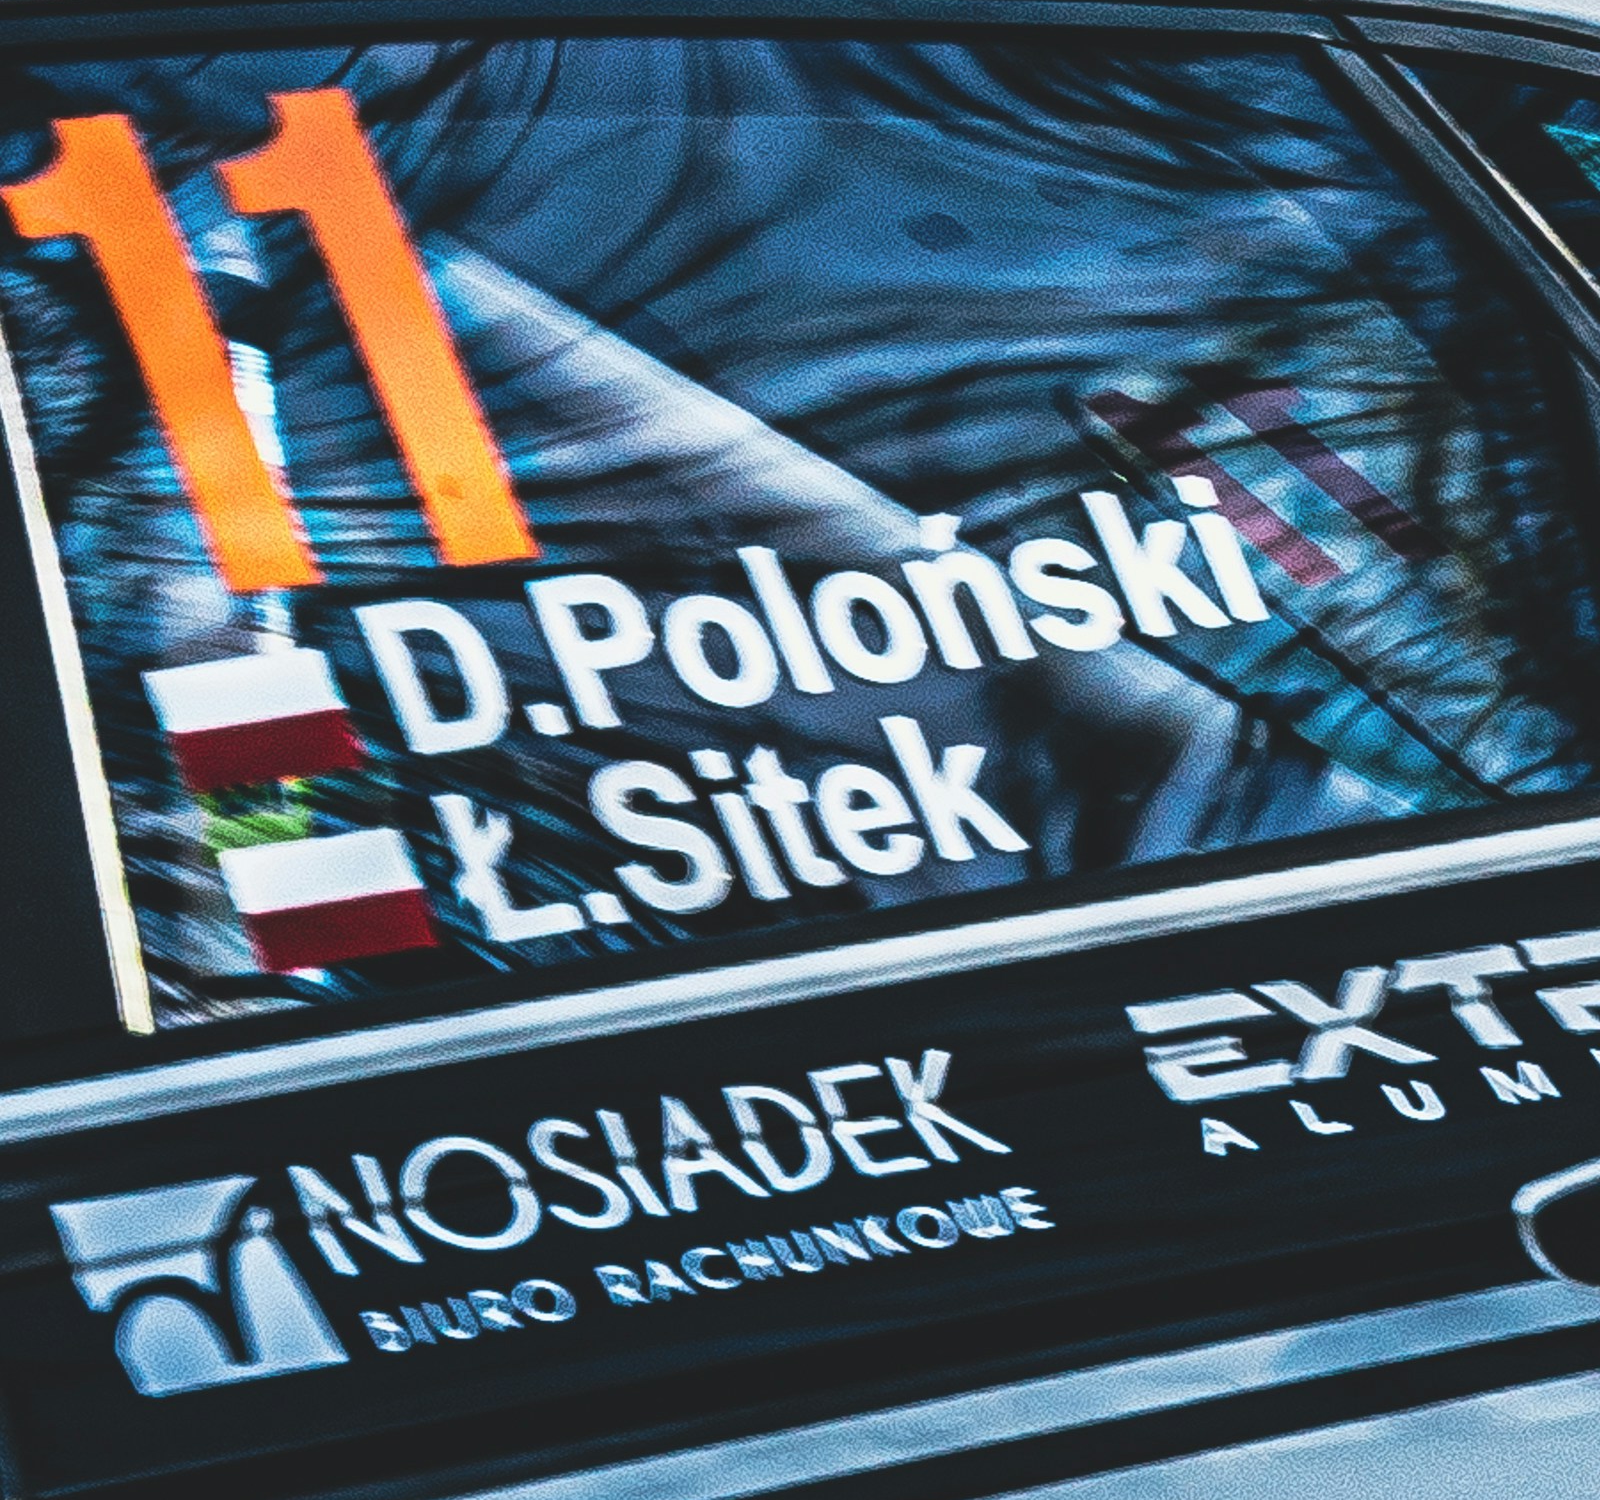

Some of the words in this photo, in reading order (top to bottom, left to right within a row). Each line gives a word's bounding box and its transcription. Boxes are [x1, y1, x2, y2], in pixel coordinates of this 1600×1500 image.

[0, 87, 541, 594] 11
[355, 474, 1271, 756] D.Poloński
[431, 714, 1030, 943] Ł.Sitek
[286, 1048, 1013, 1277] NOSIADEK
[358, 1278, 577, 1353] BIURO
[592, 1185, 1057, 1307] RACHUNKOWE
